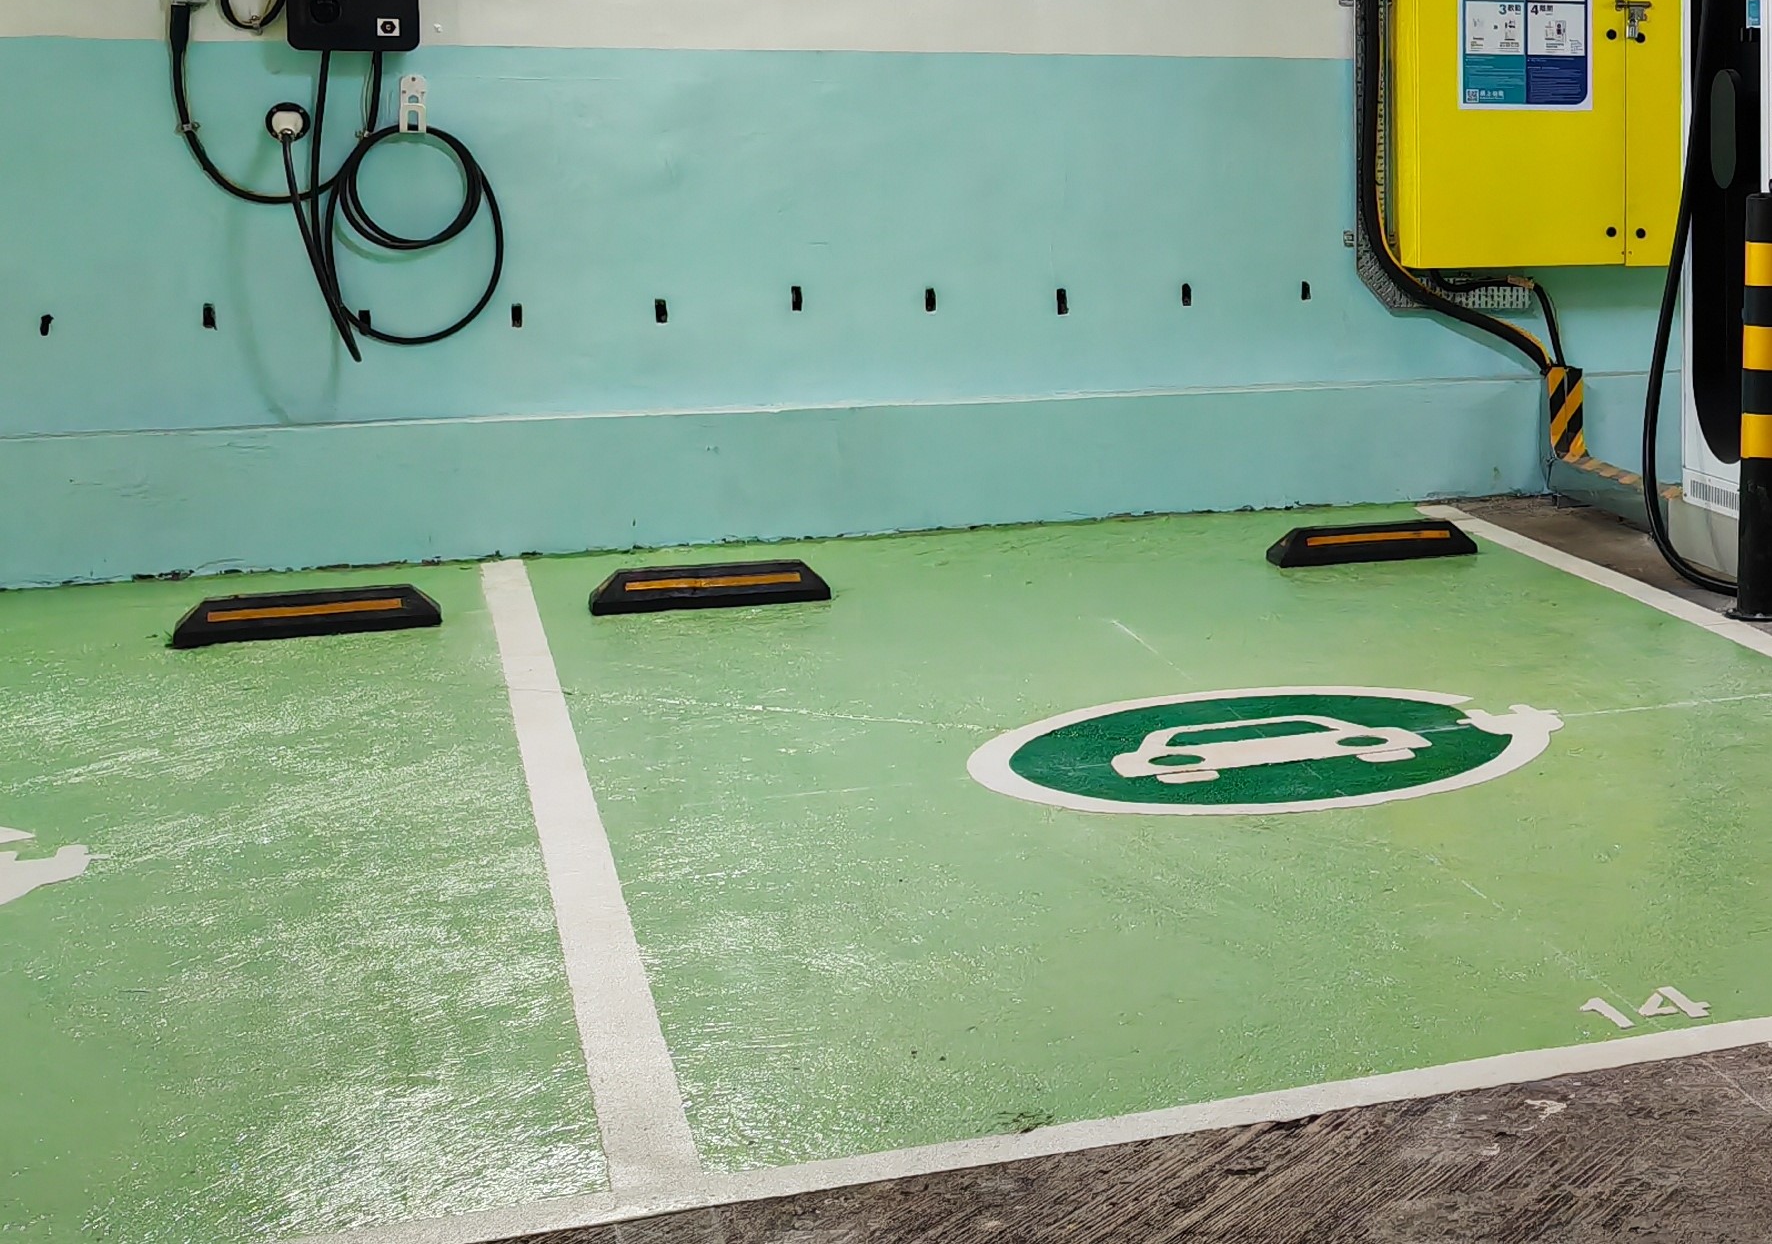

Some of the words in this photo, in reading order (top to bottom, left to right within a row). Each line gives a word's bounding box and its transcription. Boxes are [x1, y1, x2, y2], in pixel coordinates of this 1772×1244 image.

[1499, 4, 1507, 15] 3
[1530, 4, 1539, 15] 4
[1579, 986, 1712, 1029] 14
